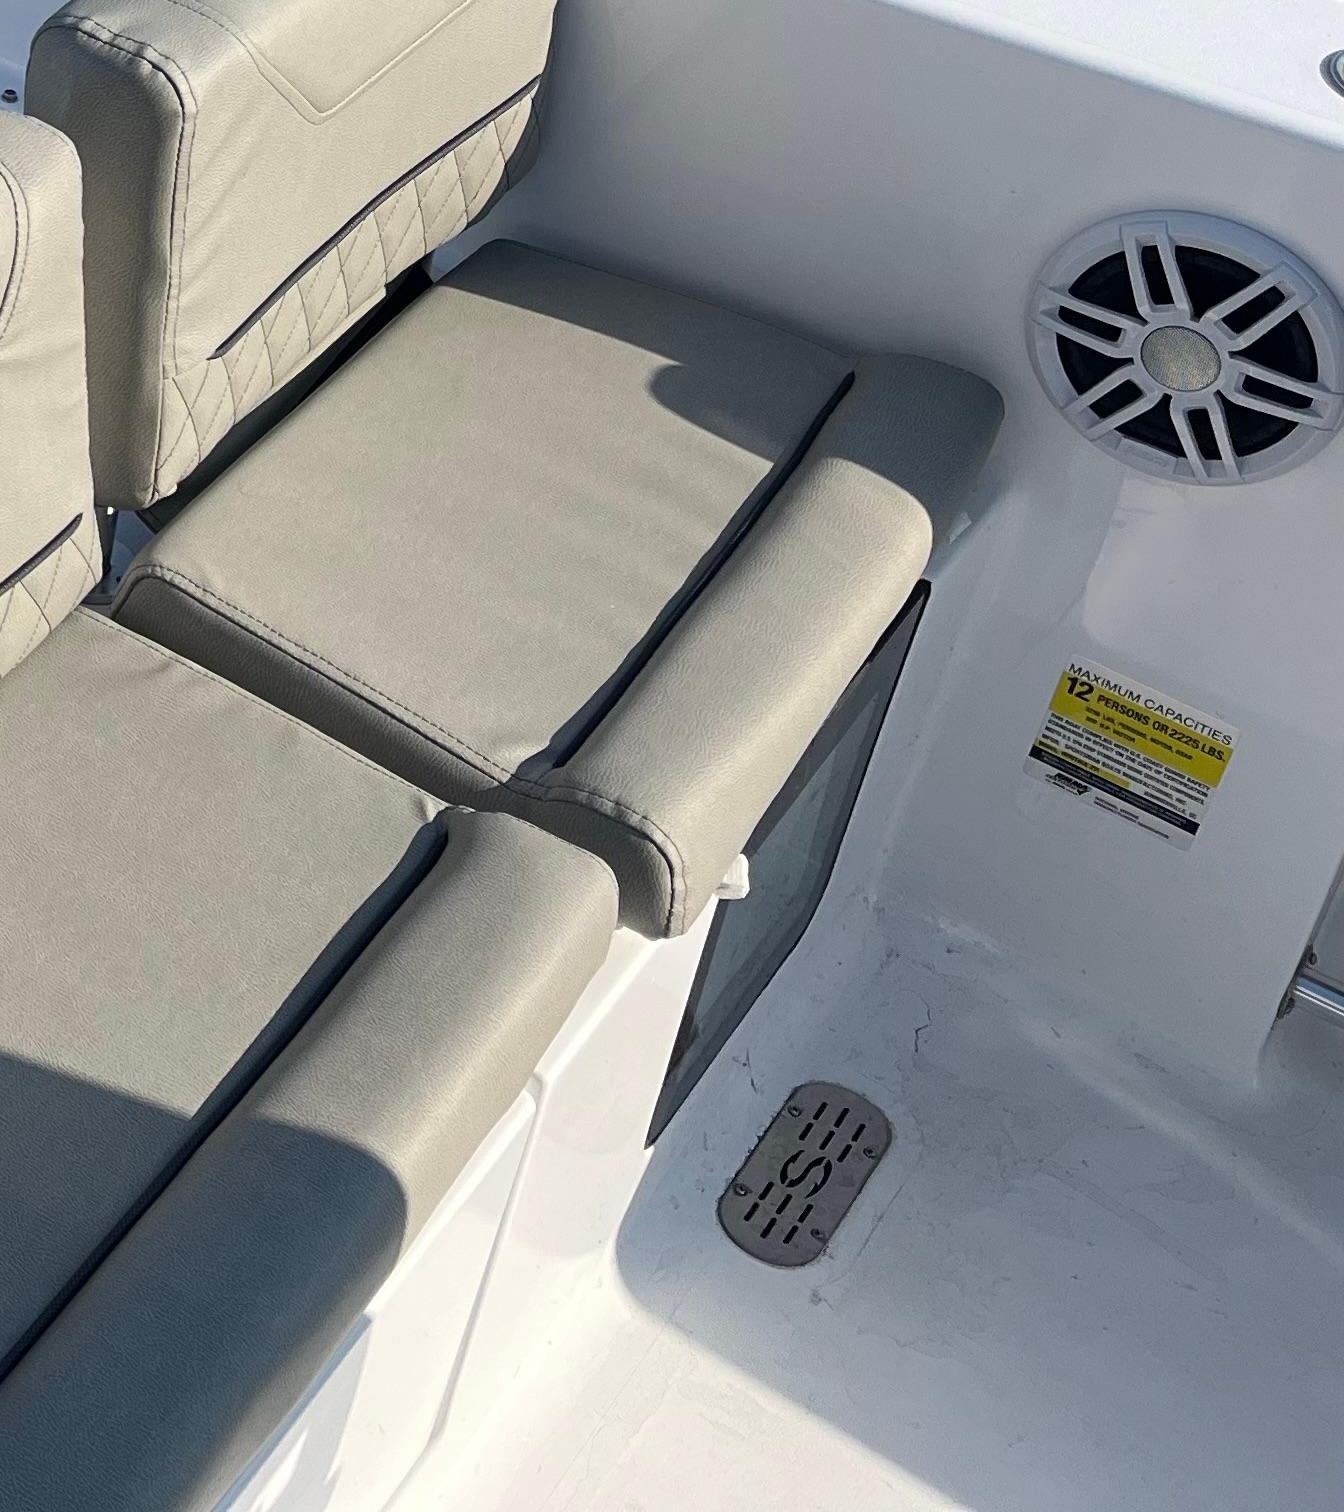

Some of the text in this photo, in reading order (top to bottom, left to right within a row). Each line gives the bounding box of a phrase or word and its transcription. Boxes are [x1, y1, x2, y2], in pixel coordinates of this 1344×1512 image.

[1067, 676, 1095, 702] 12
[1097, 694, 1151, 726] PERSONS
[1152, 720, 1169, 735] OR
[1169, 728, 1201, 749] 2225
[1069, 663, 1142, 703] MAXIMUM
[1144, 698, 1233, 746] CAPACITIES
